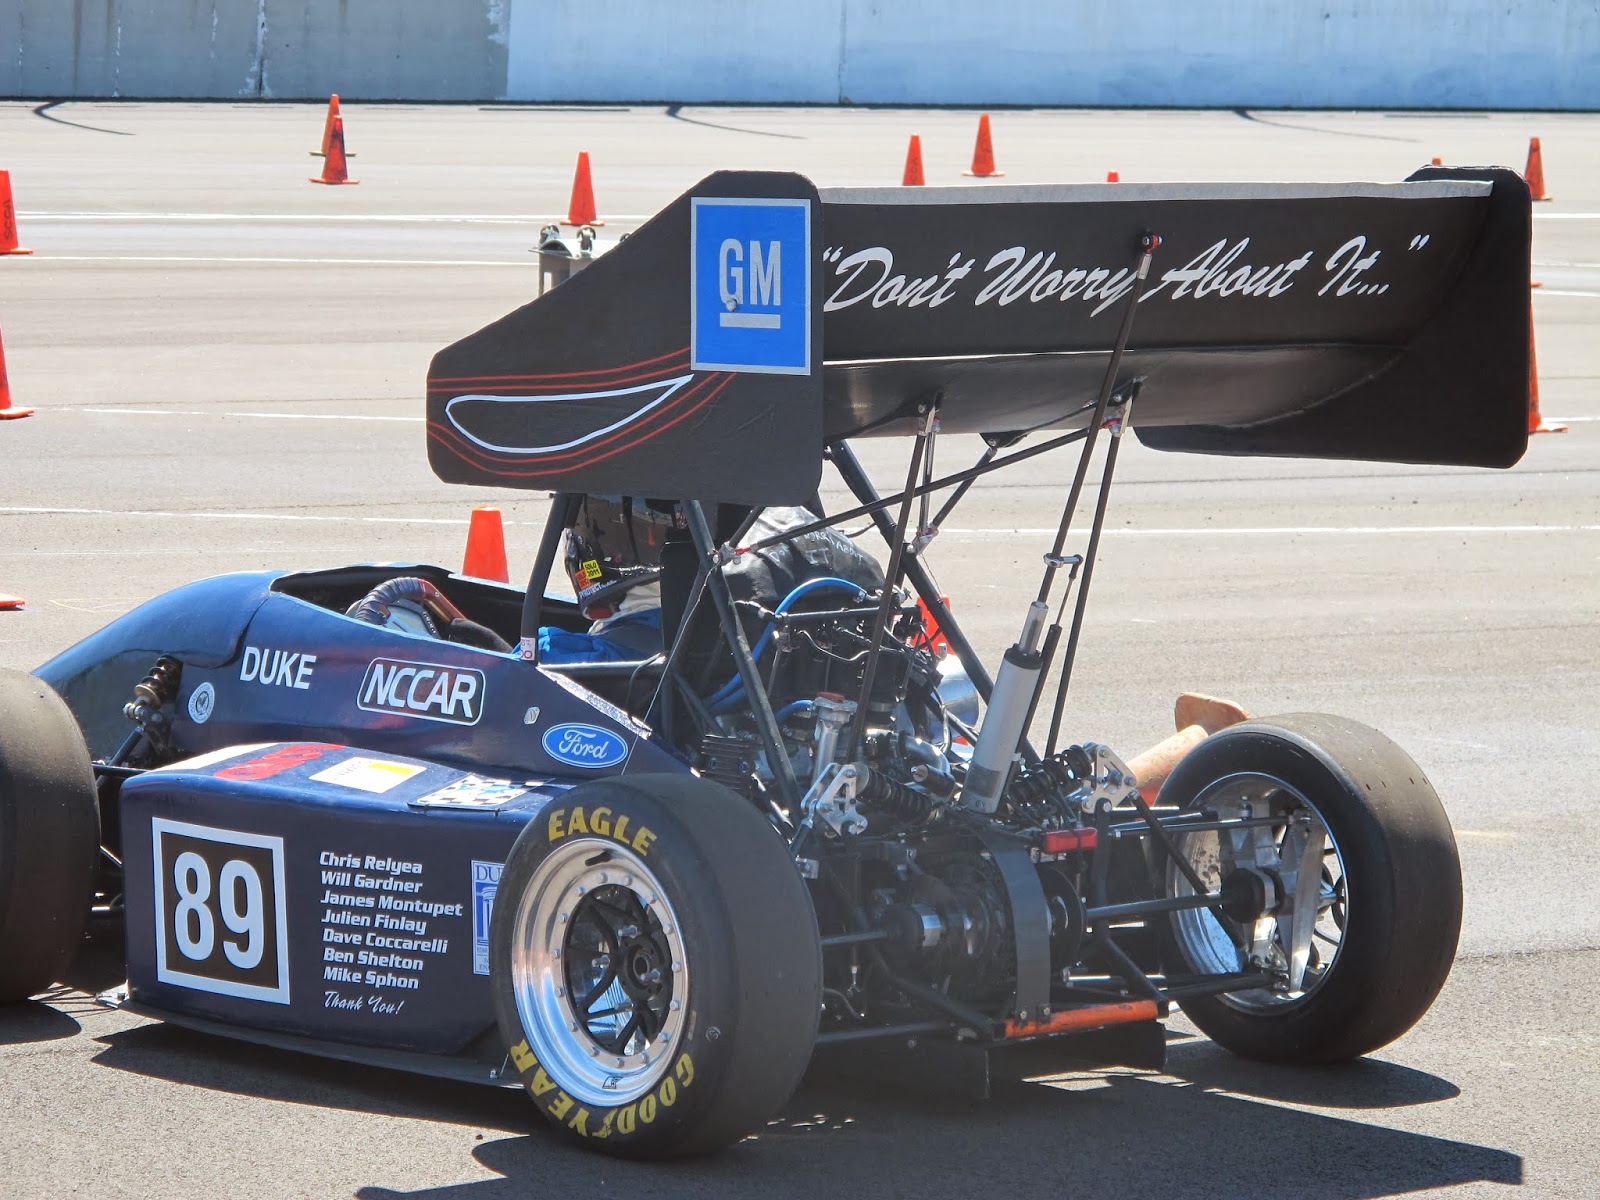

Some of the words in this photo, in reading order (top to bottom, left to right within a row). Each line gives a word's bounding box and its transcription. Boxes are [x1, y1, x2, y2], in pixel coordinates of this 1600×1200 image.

[719, 238, 781, 306] GM
[975, 246, 1140, 318] Worry
[1138, 237, 1314, 303] About
[240, 646, 316, 690] DUKE
[363, 664, 478, 718] NCCAR
[558, 729, 609, 759] Ford
[548, 806, 658, 856] EAGLE
[319, 851, 361, 869] Chris
[364, 855, 423, 875] Relyea
[475, 865, 504, 882] DU
[321, 871, 351, 886] Will
[354, 874, 423, 893] Gardner
[174, 851, 265, 969] 89
[320, 890, 375, 908] James
[378, 895, 463, 917] Montupet
[321, 909, 371, 927] Julien
[374, 914, 427, 935] Finlay
[322, 928, 362, 945] Dave
[365, 932, 448, 953] Coccarelli
[323, 947, 354, 963] Ben
[357, 951, 424, 970] Shelton
[323, 966, 362, 983] Mike
[365, 971, 420, 989] Sphon
[323, 991, 363, 1010] Thank
[367, 995, 405, 1015] You!
